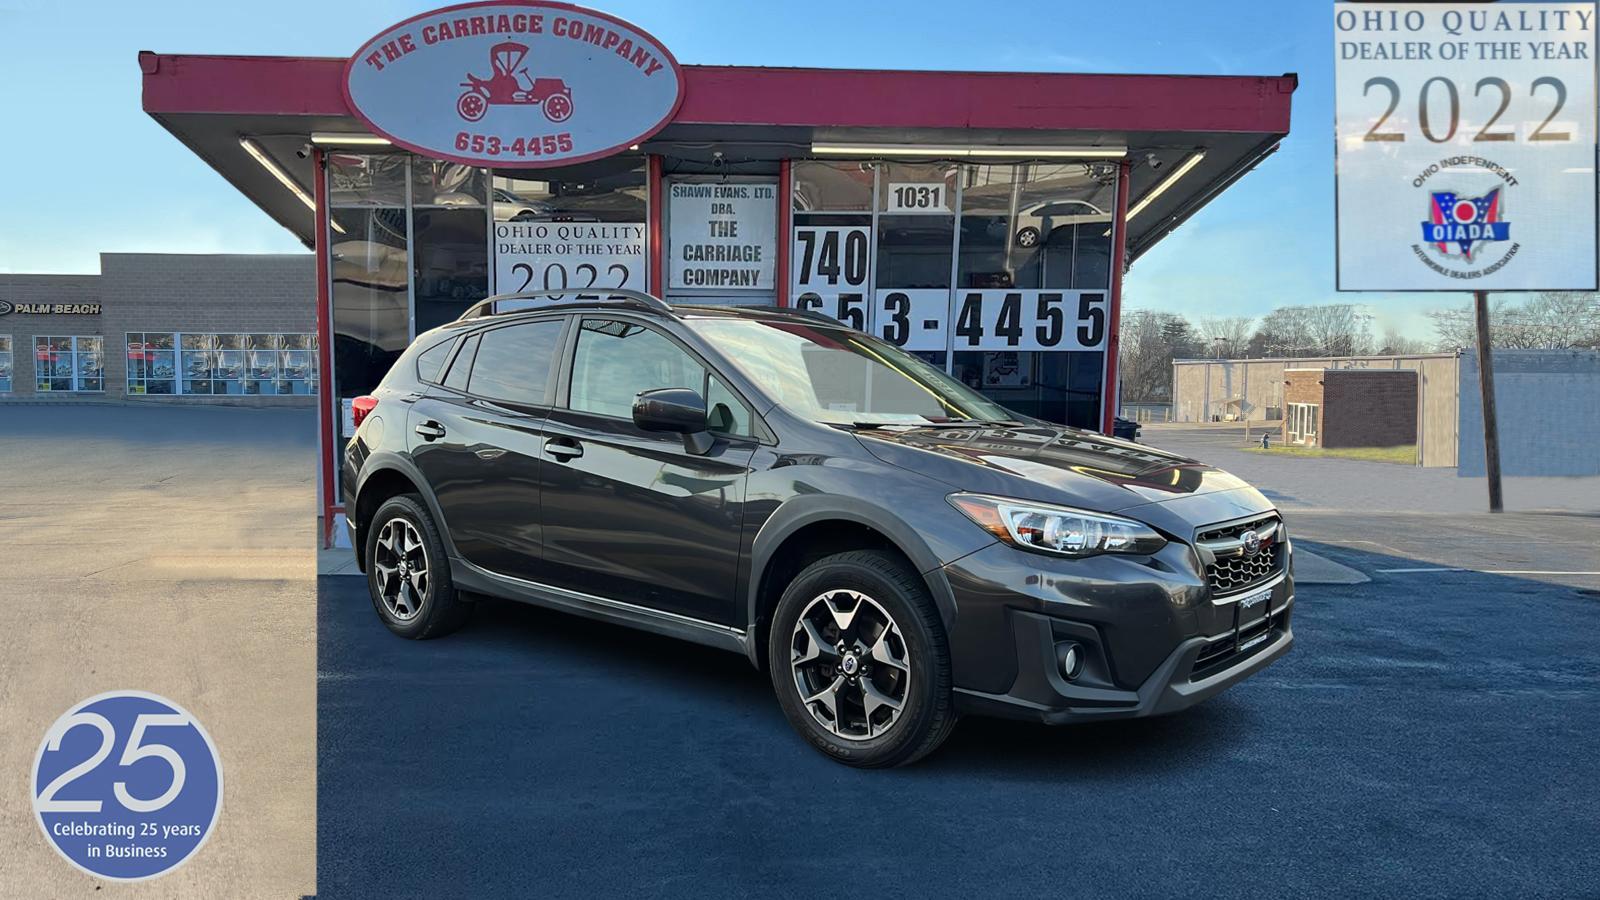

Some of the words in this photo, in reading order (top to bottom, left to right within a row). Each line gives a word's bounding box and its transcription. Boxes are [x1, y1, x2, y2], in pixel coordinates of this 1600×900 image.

[1336, 10, 1425, 31] OHIO
[1442, 10, 1592, 36] QUALITY
[365, 33, 416, 72] THE
[422, 14, 544, 45] CARRIAGE
[552, 17, 665, 77] COMPANY
[1340, 42, 1433, 60] DEALER
[1439, 42, 1470, 60] OF
[1475, 42, 1521, 60] THE
[1528, 42, 1589, 60] YEAR
[1363, 76, 1570, 143] 2022
[455, 132, 573, 156] 653-4455
[1413, 164, 1439, 188] OHIO
[1440, 156, 1519, 187] INDEPENDENT
[672, 186, 712, 199] SHAWN
[754, 186, 775, 199] LTD.
[894, 187, 940, 209] 1031
[711, 203, 736, 215] DBA.
[497, 226, 548, 239] OHIO
[558, 226, 644, 241] QUALITY
[708, 220, 738, 238] THE
[1432, 224, 1495, 241] OIADA
[500, 244, 552, 255] DEALER
[556, 244, 574, 255] OF
[576, 244, 603, 255] THE
[605, 244, 642, 255] YEAR
[683, 245, 762, 262] CARRIAGE
[797, 230, 868, 286] 740
[511, 262, 630, 301] 2022
[683, 269, 760, 286] COMPANY
[15, 304, 51, 313] PALM
[54, 304, 100, 314] BEACH
[796, 292, 1105, 347] 53-4455
